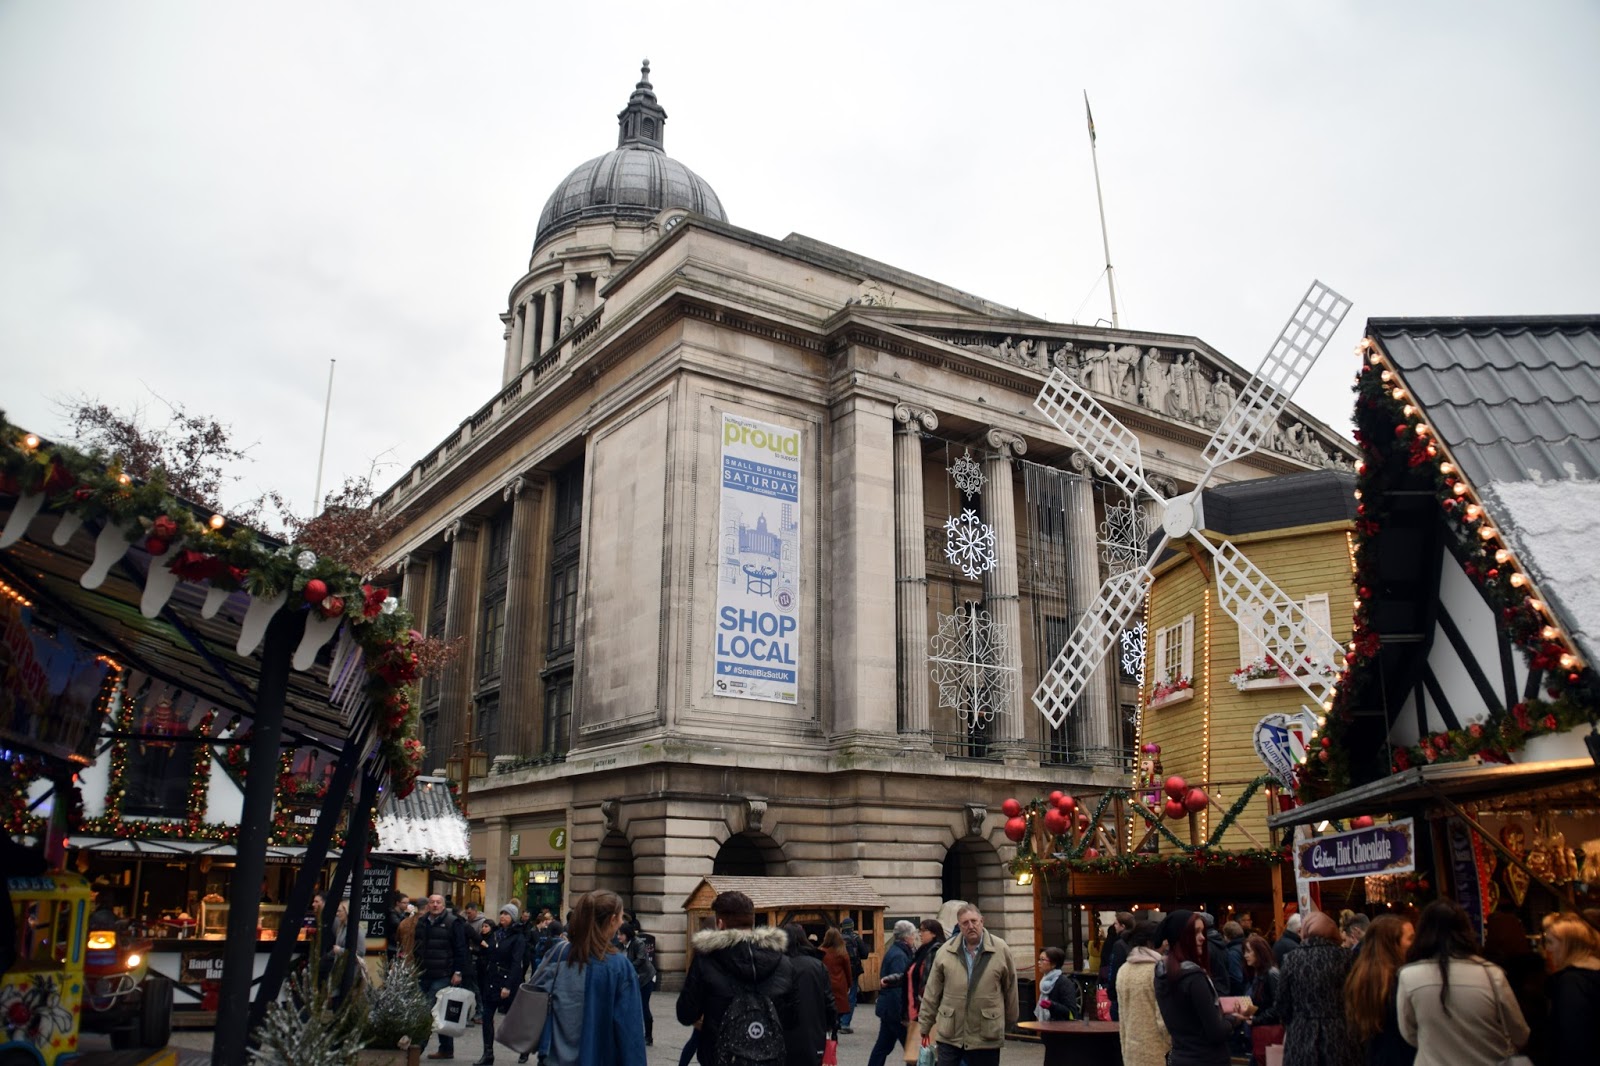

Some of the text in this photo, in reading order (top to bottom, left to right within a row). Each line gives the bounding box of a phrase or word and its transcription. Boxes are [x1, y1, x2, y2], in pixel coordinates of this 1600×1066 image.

[724, 422, 798, 456] proud
[781, 454, 798, 462] support
[725, 459, 797, 480] SMALL BUSINESS
[724, 470, 797, 494] SATURDAY
[719, 606, 796, 638] SHOP
[717, 633, 796, 665] LOCAL
[733, 667, 789, 680] #SmallBizSatUK
[1312, 845, 1336, 870] Cadbury
[1336, 841, 1352, 866] Hot
[1352, 832, 1392, 864] Chocolate
[376, 877, 390, 886] and
[371, 921, 385, 935] £5
[189, 959, 213, 969] Hand
